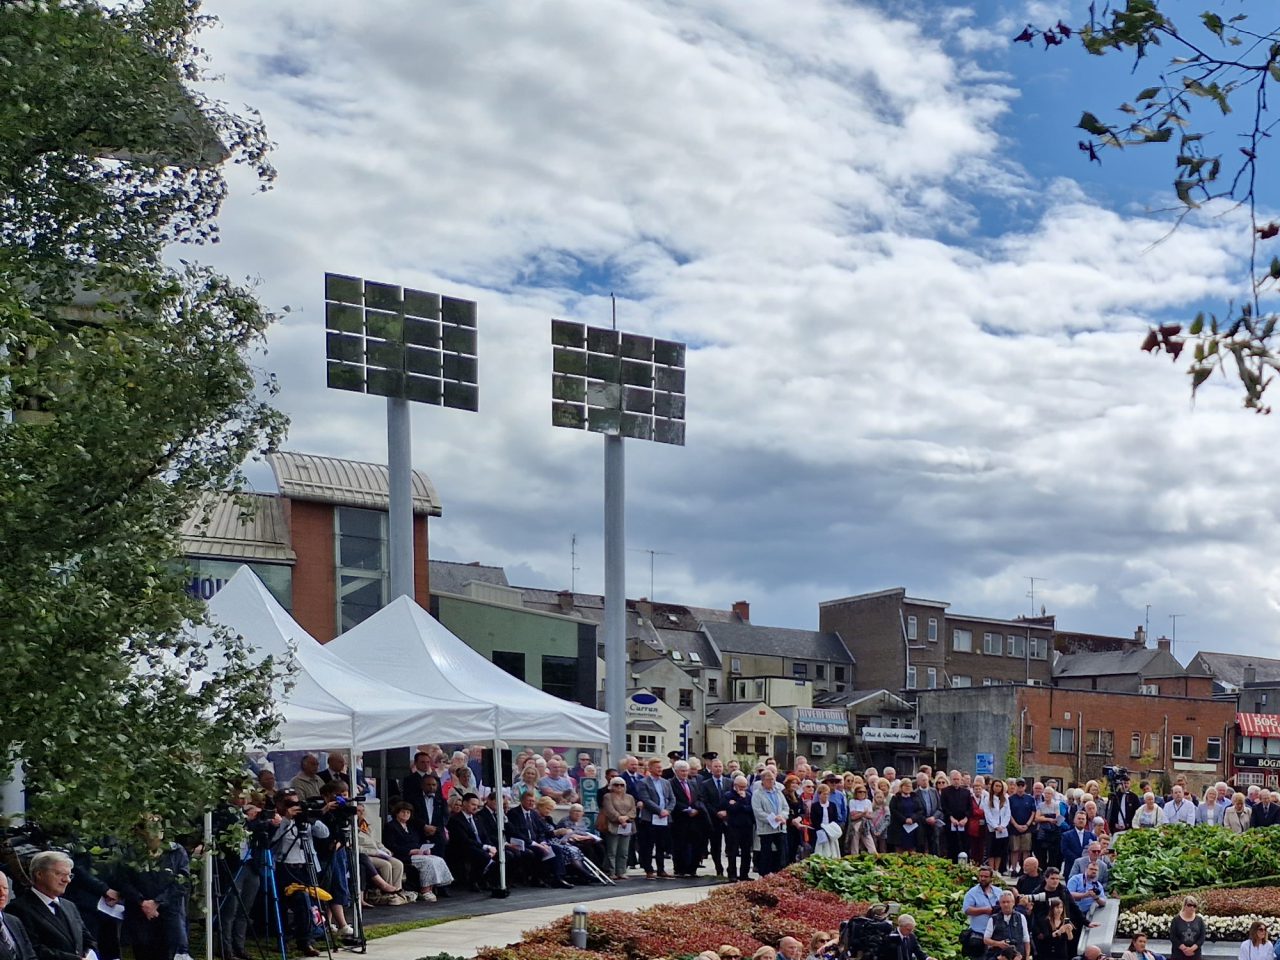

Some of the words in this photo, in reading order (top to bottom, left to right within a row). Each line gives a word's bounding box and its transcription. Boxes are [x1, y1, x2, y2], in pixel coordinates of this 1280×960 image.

[798, 708, 846, 721] RIVERFRONT
[799, 721, 827, 732] Coffee
[827, 724, 849, 735] Shop
